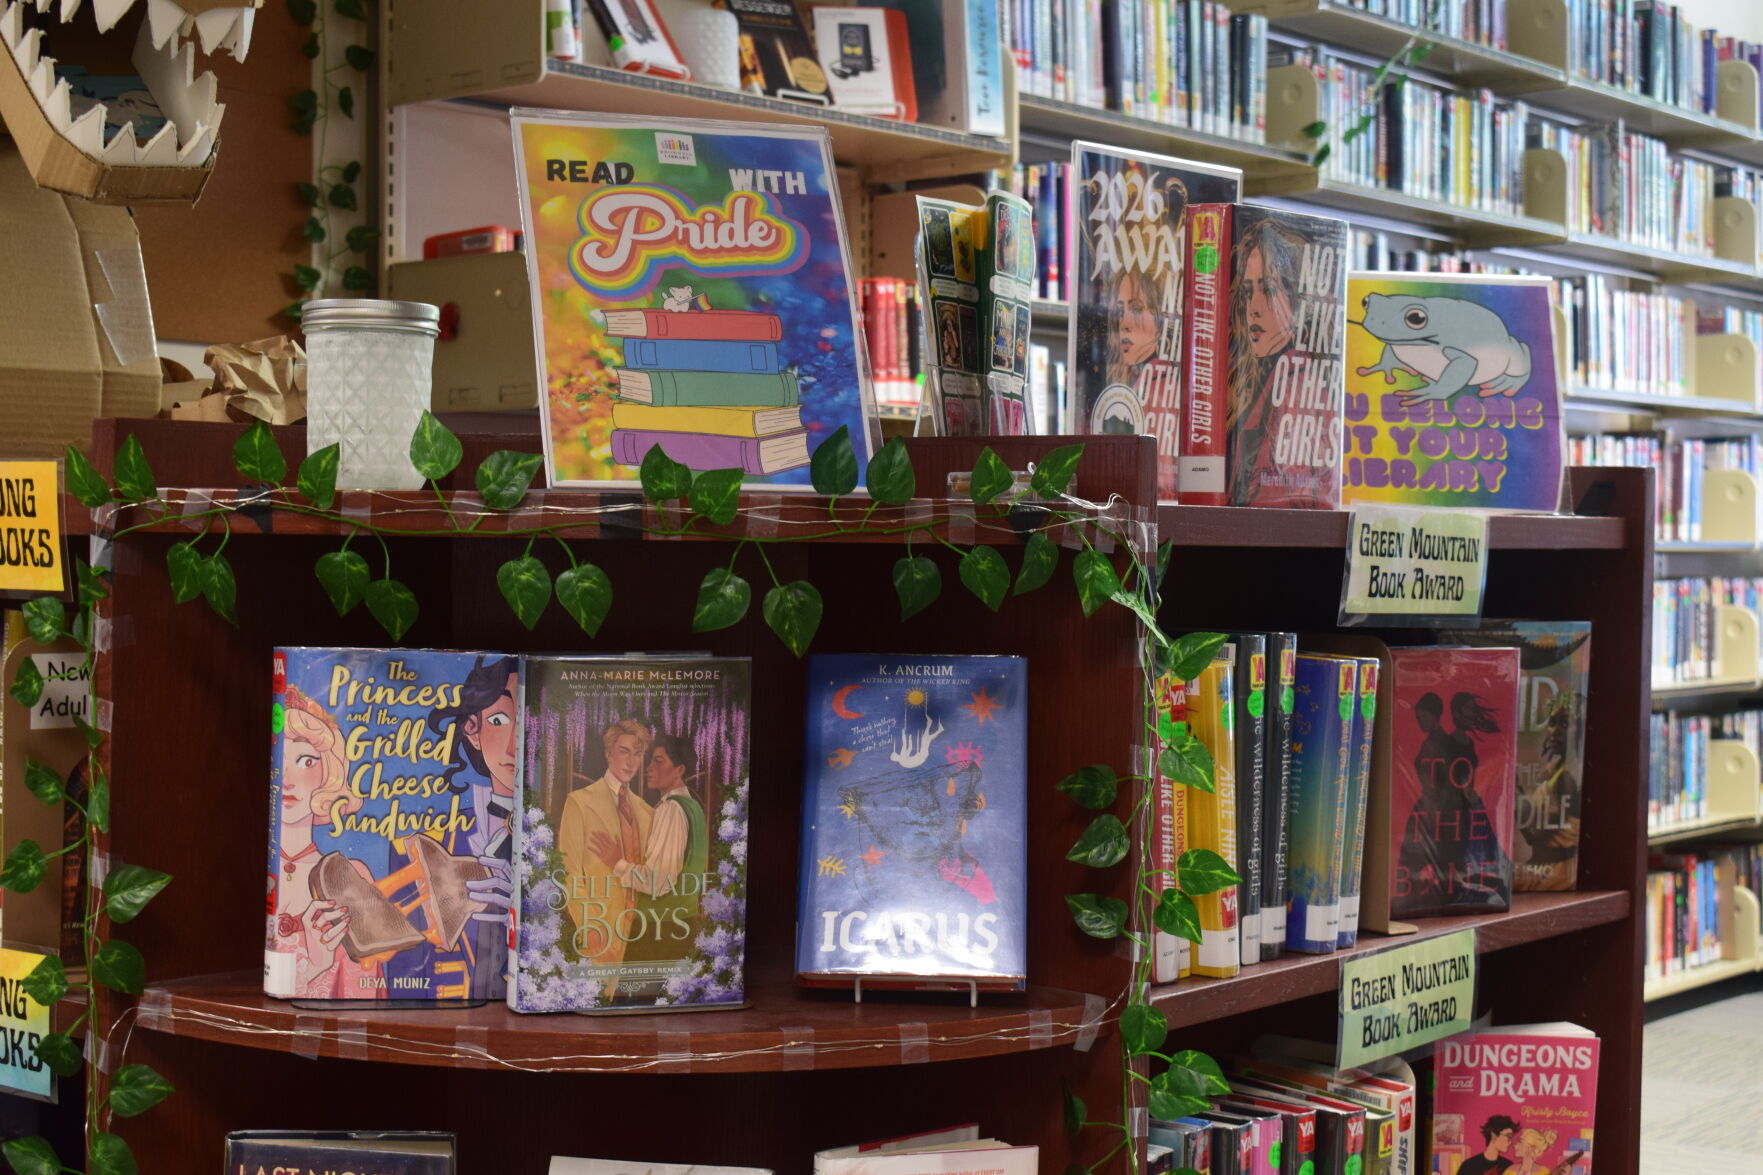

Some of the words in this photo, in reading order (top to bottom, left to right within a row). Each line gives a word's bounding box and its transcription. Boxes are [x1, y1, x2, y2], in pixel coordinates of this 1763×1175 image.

[546, 159, 635, 185] READ
[729, 168, 807, 195] WITH
[1088, 170, 1166, 222] 2026
[582, 193, 777, 272] Pride
[1298, 243, 1346, 298] NOT
[1194, 273, 1215, 306] NOT
[1194, 308, 1214, 343] LIKE
[1295, 302, 1345, 355] LIKE
[1138, 362, 1181, 409] OTH
[1193, 346, 1214, 395] OTHER
[1272, 358, 1343, 410] OTHER
[1192, 397, 1212, 445] GIRLS
[1381, 393, 1544, 428] BELONG
[1274, 411, 1341, 468] GIRLS
[1389, 425, 1507, 461] YOUR
[1359, 523, 1403, 558] GREEN
[1409, 526, 1480, 563] MOUNTAIN
[1368, 566, 1405, 599] BOOK
[1411, 567, 1464, 601] AWARD
[329, 664, 465, 708] Princess
[388, 661, 418, 682] The
[560, 670, 645, 681] ANNA-MARIE
[649, 670, 720, 681] McLEMORE
[879, 664, 891, 676] K.
[896, 665, 953, 676] ANCRUM
[40, 694, 87, 717] Adul
[1171, 690, 1186, 706] YA
[346, 707, 371, 725] and
[376, 708, 399, 726] the
[1254, 713, 1264, 735] he
[345, 720, 457, 766] Grilled
[350, 762, 450, 801] Cheese
[1253, 742, 1263, 832] wilderness
[1281, 738, 1291, 827] wilderness
[1420, 757, 1474, 789] TO
[1220, 765, 1236, 819] AISLE
[329, 795, 476, 841] Sandwich
[1409, 809, 1490, 843] THE
[1161, 814, 1174, 863] OTHER
[1221, 829, 1237, 867] NIN
[1253, 837, 1262, 851] of
[1248, 859, 1260, 896] girls
[572, 902, 691, 958] BOYS
[819, 909, 999, 954] ICARUS
[359, 977, 387, 990] DEYA
[393, 978, 431, 990] MUNIZ
[587, 968, 617, 976] GREAT
[619, 967, 655, 975] GATSBY
[1351, 976, 1396, 1011] GREEN
[1401, 953, 1470, 995] MOUNTAIN
[1361, 1014, 1401, 1049] BOOK
[1406, 996, 1457, 1036] AWARD
[1443, 1041, 1593, 1069] DUNGEONS
[1449, 1077, 1474, 1089] and
[1479, 1069, 1582, 1103] DRAMA
[1400, 1101, 1412, 1117] YA
[1240, 1136, 1252, 1153] YA
[1299, 1120, 1315, 1137] YA
[1347, 1120, 1364, 1137] YA
